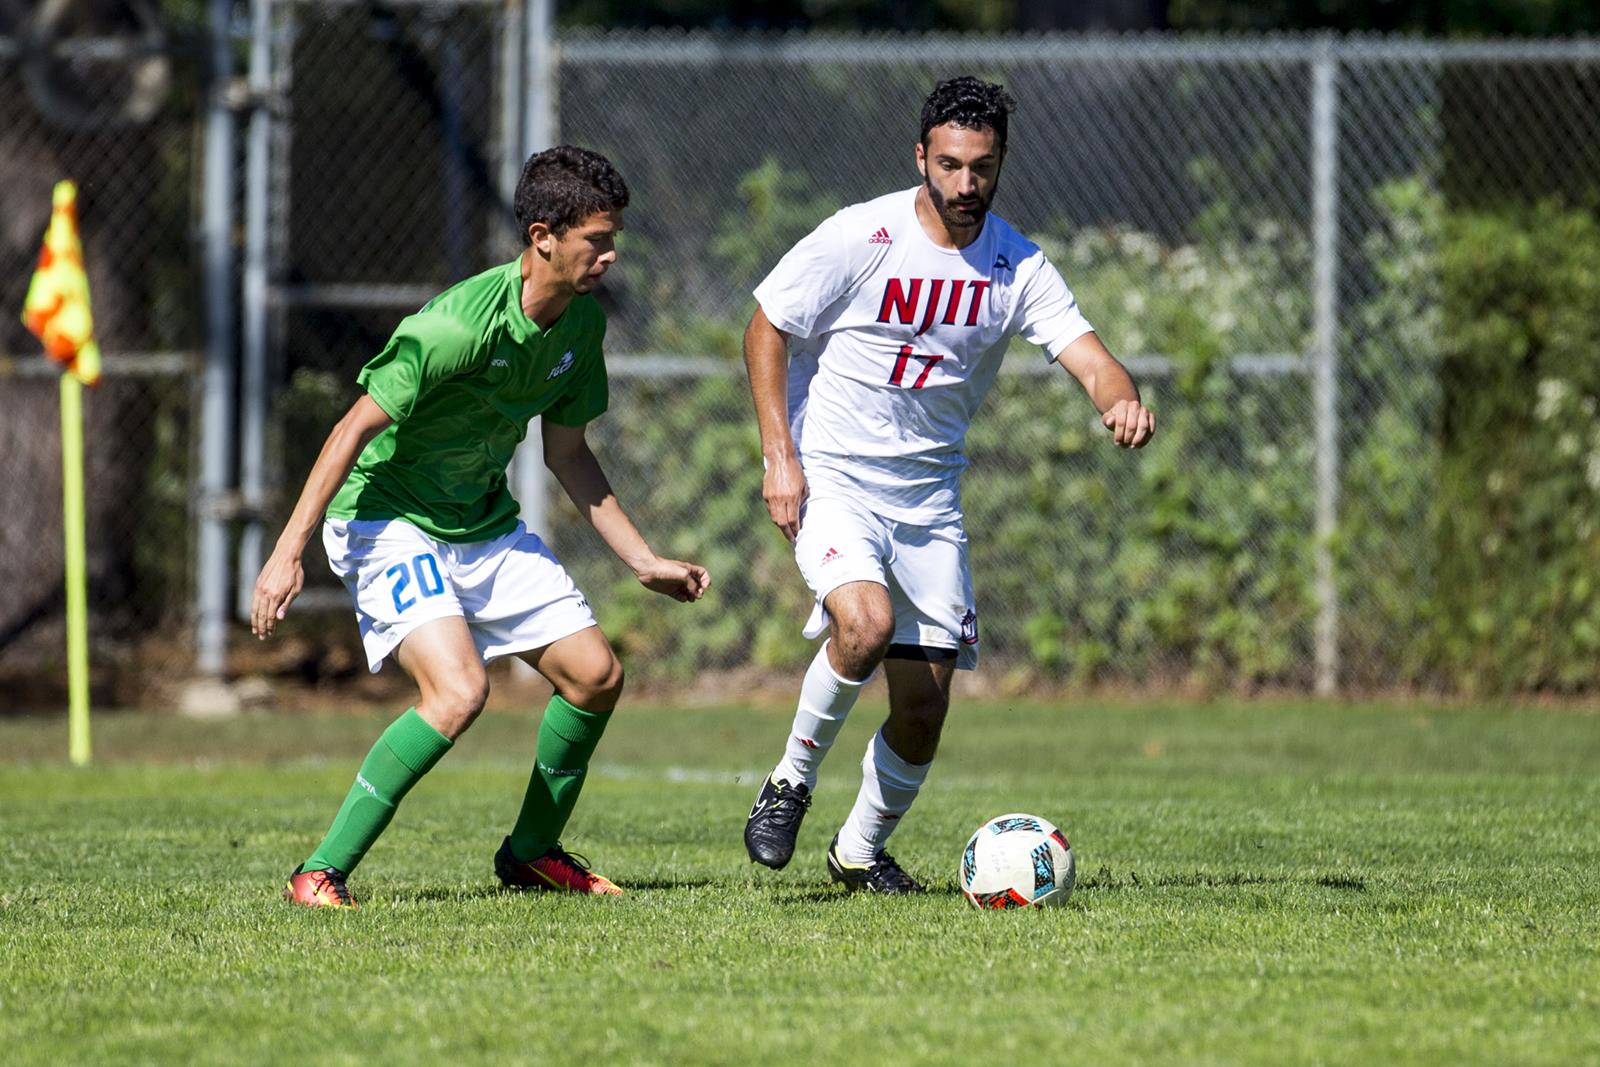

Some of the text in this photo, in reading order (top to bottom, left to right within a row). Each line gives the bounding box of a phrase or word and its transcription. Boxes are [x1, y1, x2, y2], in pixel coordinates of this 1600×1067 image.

[875, 278, 991, 337] NJIT
[887, 344, 944, 389] 17
[386, 553, 445, 615] 20
